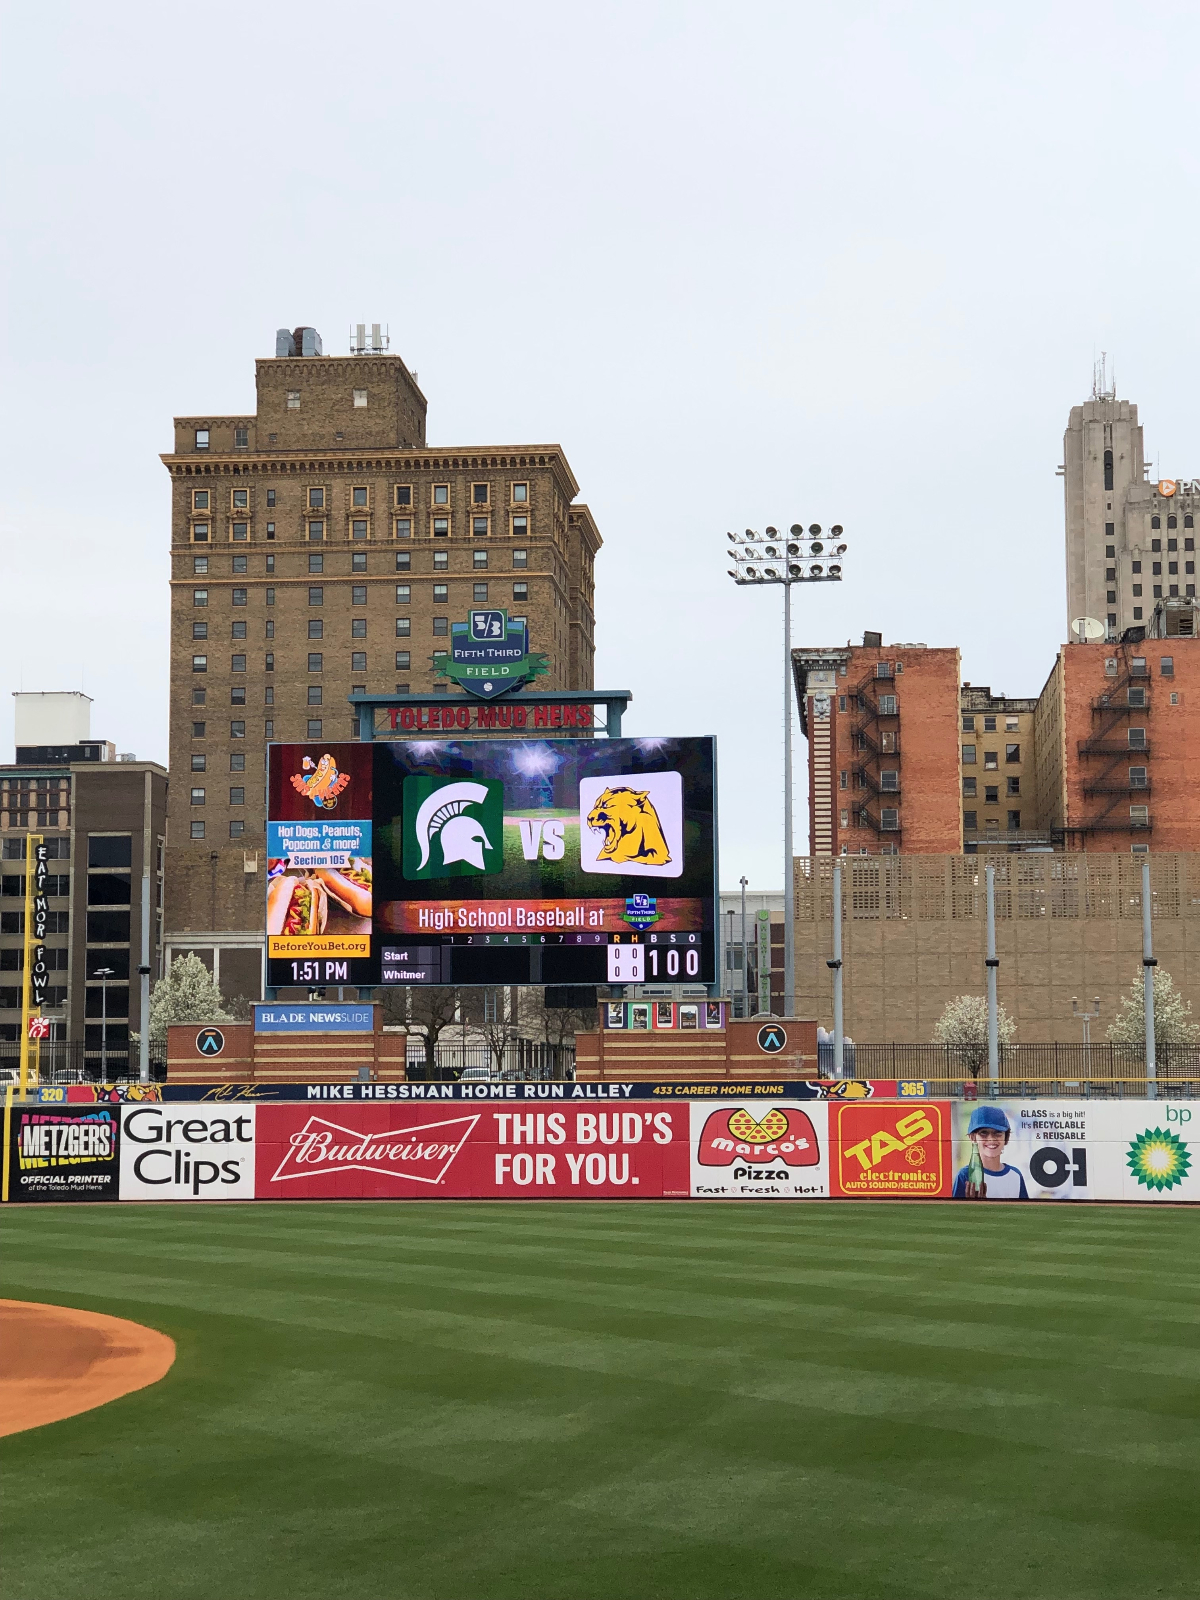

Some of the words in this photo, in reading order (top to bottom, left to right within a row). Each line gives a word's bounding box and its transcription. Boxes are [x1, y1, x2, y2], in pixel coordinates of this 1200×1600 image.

[454, 649, 485, 659] FIFTH
[487, 648, 522, 658] THIRD
[466, 667, 510, 676] FIELD
[388, 707, 470, 729] TOLEDO
[477, 706, 527, 728] MUD
[534, 705, 591, 728] HENS
[278, 825, 294, 837] Hot
[296, 825, 321, 838] Dogs,
[322, 824, 363, 837] Peanuts,
[282, 838, 320, 851] Popcorn
[322, 838, 331, 849] &
[333, 838, 360, 850] more!
[519, 820, 565, 860] VS
[294, 855, 327, 865] Section
[330, 855, 345, 865] 105
[37, 847, 47, 889] EAT
[36, 898, 47, 937] MOR
[419, 908, 454, 930] High
[458, 907, 512, 927] School
[516, 907, 585, 927] Baseball
[589, 909, 604, 926] at
[521, 935, 527, 943] 5
[540, 935, 546, 943] 6
[613, 934, 620, 943] R
[631, 934, 638, 943] H
[650, 934, 658, 943] B
[670, 934, 676, 942] S
[272, 941, 367, 952] BeforeYouBet.org
[384, 951, 408, 961] Start
[614, 948, 620, 959] 0
[632, 948, 638, 959] 0
[33, 947, 47, 1003] FOWL
[291, 961, 319, 980] 1:51
[326, 961, 347, 980] PM
[383, 970, 425, 979] Whitmer
[614, 966, 620, 977] 0
[632, 966, 638, 977] 0
[261, 1013, 306, 1023] BLADE
[309, 1012, 369, 1023] NEWSSLIDE
[41, 1088, 64, 1101] 320
[307, 1085, 354, 1099] MIKE
[361, 1085, 453, 1098] HESSMAN
[461, 1085, 517, 1097] HOME
[524, 1084, 564, 1097] RUN
[571, 1084, 634, 1097] ALLEY
[653, 1086, 673, 1095] 433
[675, 1086, 719, 1095] CAREER
[720, 1086, 752, 1095] HOME
[753, 1085, 784, 1094] RUNS
[901, 1083, 925, 1096] 365
[1020, 1109, 1047, 1118] GLASS
[1062, 1111, 1073, 1119] big
[1074, 1110, 1086, 1118] hit!
[1166, 1104, 1192, 1126] bp
[123, 1108, 253, 1143] Great
[493, 1112, 567, 1145] THIS
[576, 1112, 673, 1145] BUD'S
[1021, 1121, 1032, 1129] It's
[1033, 1121, 1086, 1129] RECYCLABLE
[23, 1124, 111, 1156] METZGERS
[843, 1109, 934, 1171] TAS
[1043, 1131, 1086, 1140] REUSABLE
[289, 1131, 458, 1164] Budweiser
[133, 1149, 241, 1195] Clips
[495, 1152, 556, 1185] FOR
[565, 1152, 640, 1185] YOU.
[734, 1165, 790, 1180] Pizza
[859, 1169, 937, 1181] electronics
[20, 1175, 66, 1184] OFFICIAL
[68, 1175, 112, 1184] PRINTER
[845, 1181, 867, 1189] AUTO
[869, 1181, 937, 1189] SOUND/SECURITY
[696, 1186, 729, 1194] Fast
[740, 1186, 780, 1194] Fresh
[794, 1185, 824, 1194] Hot!
